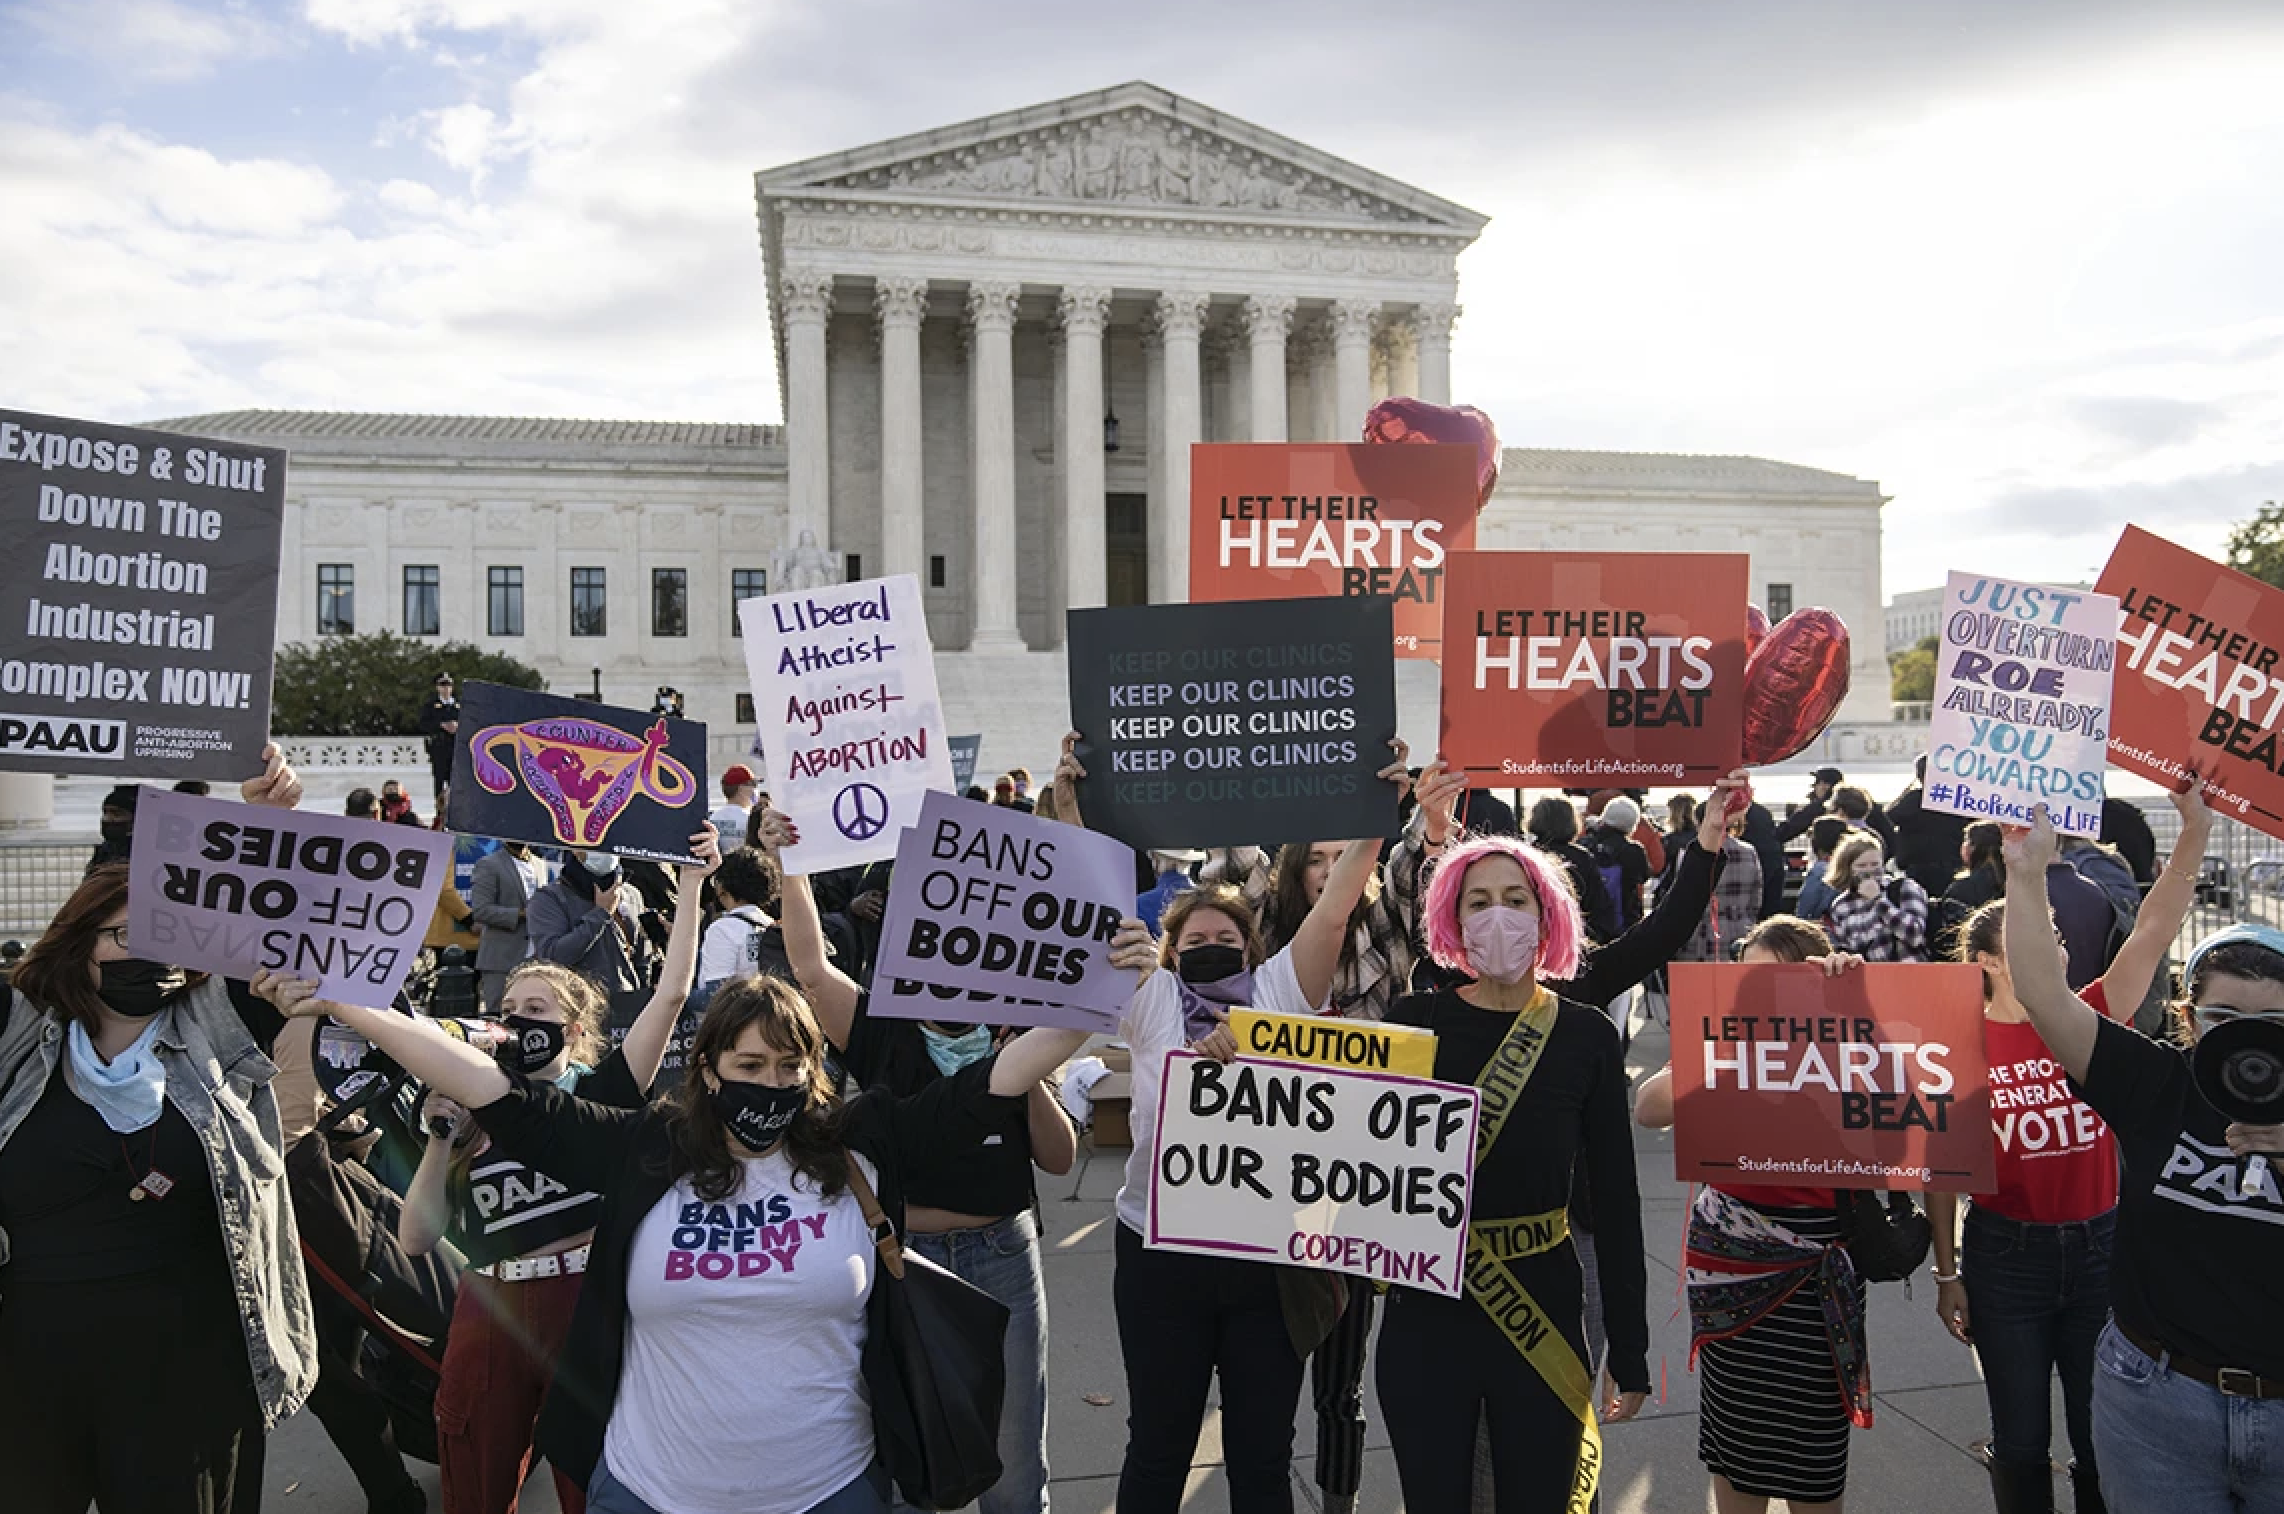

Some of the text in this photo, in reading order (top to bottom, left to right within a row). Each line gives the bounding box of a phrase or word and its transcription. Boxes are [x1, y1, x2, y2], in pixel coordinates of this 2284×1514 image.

[0, 421, 267, 493] Expose & Shut
[38, 484, 223, 540] Down The
[1220, 496, 1379, 520] LET THEIR
[1219, 519, 1445, 568] HEARTS
[44, 543, 208, 595] Abortion
[1343, 567, 1443, 603] BEAT
[27, 597, 215, 651] Industrial
[1476, 610, 1646, 637] LET THEIR
[1958, 579, 2082, 626] JUST
[1948, 609, 2114, 672] OVERTURN
[2120, 586, 2279, 676] LET THEIR
[0, 657, 251, 709] omplex NOW!
[1109, 643, 1353, 675] KEEP OUR CLINICS
[1474, 635, 1714, 690] HEARTS
[1951, 650, 2065, 698] ROE
[2116, 608, 2284, 731] HEART
[786, 683, 904, 736] Against
[1109, 674, 1355, 707] KEEP OUR CLINICS
[1607, 688, 1712, 728] BEAT
[1, 719, 120, 754] PAAU
[135, 726, 222, 741] PROGRESSIVE
[135, 737, 233, 751] ANTI-ABORTION
[1110, 707, 1356, 741] KEEP OUR CLINICS
[1969, 715, 2054, 762] YOU
[2199, 707, 2284, 777] BEA
[134, 748, 194, 760] UPRISING
[1112, 740, 1357, 773] KEEP OUR CLINICS
[1501, 759, 1685, 778] StudentsforLifeAction.org
[1114, 774, 1357, 804] KEEP OUR CLINICS
[200, 820, 430, 890] BODIES
[931, 817, 1056, 881] BANS
[163, 863, 298, 920] OUR
[308, 886, 414, 936] OFF
[921, 870, 1122, 944] OFF OUR
[260, 929, 399, 985] BANS
[906, 917, 1090, 985] BODIES
[1250, 1019, 1391, 1068] CAUTION
[1702, 1015, 1875, 1043] LET THEIR
[661, 1054, 682, 1069] UR
[1703, 1040, 1954, 1094] HEARTS
[1189, 1060, 1473, 1153] BANS OFF
[1842, 1092, 1954, 1132] BEAT
[1990, 1078, 2072, 1109] ENERAT
[1161, 1143, 1466, 1229] OUR BODIES
[1737, 1155, 1931, 1182] StudentsforLifeAction.org
[672, 1211, 829, 1253] OFF MY
[678, 1194, 792, 1230] BANS
[664, 1241, 802, 1281] BODY
[1287, 1231, 1447, 1292] CODEPINK
[1464, 1247, 1549, 1352] AUTION
